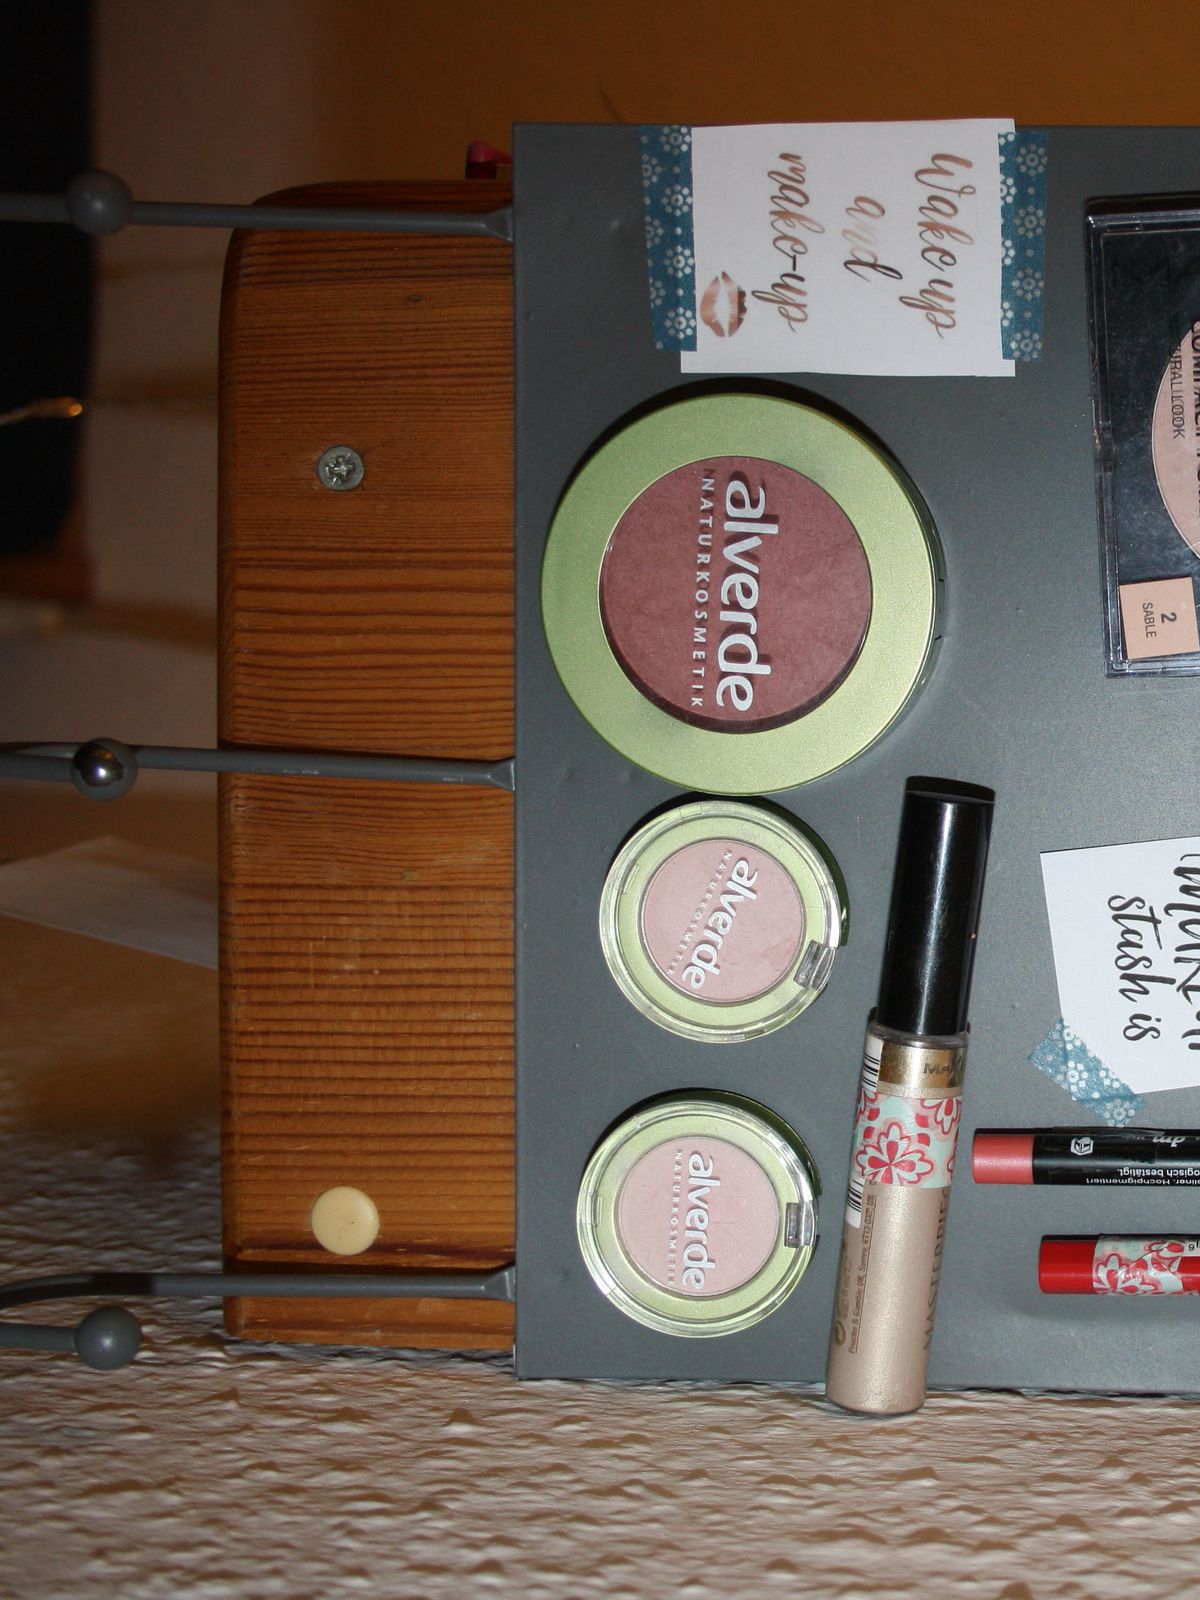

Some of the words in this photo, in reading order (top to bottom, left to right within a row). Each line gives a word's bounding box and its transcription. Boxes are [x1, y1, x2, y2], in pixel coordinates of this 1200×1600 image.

[752, 153, 825, 332] make-up
[841, 196, 903, 282] and
[915, 153, 976, 271] Wake
[899, 279, 957, 337] up
[691, 478, 714, 707] NATURKOSMETIK
[715, 480, 779, 711] alverde
[1142, 601, 1157, 639] SABLE
[1160, 611, 1177, 623] 2
[665, 851, 732, 977] NATURKOSMETIK
[682, 859, 758, 989] alverde
[1108, 895, 1176, 1004] stash
[1123, 1014, 1162, 1042] is
[667, 1151, 683, 1288] NATURKOSMETIK
[682, 1152, 721, 1290] alverde
[1086, 1177, 1170, 1185] Hochpigmentiert
[1117, 1167, 1164, 1177] bestätigt.
